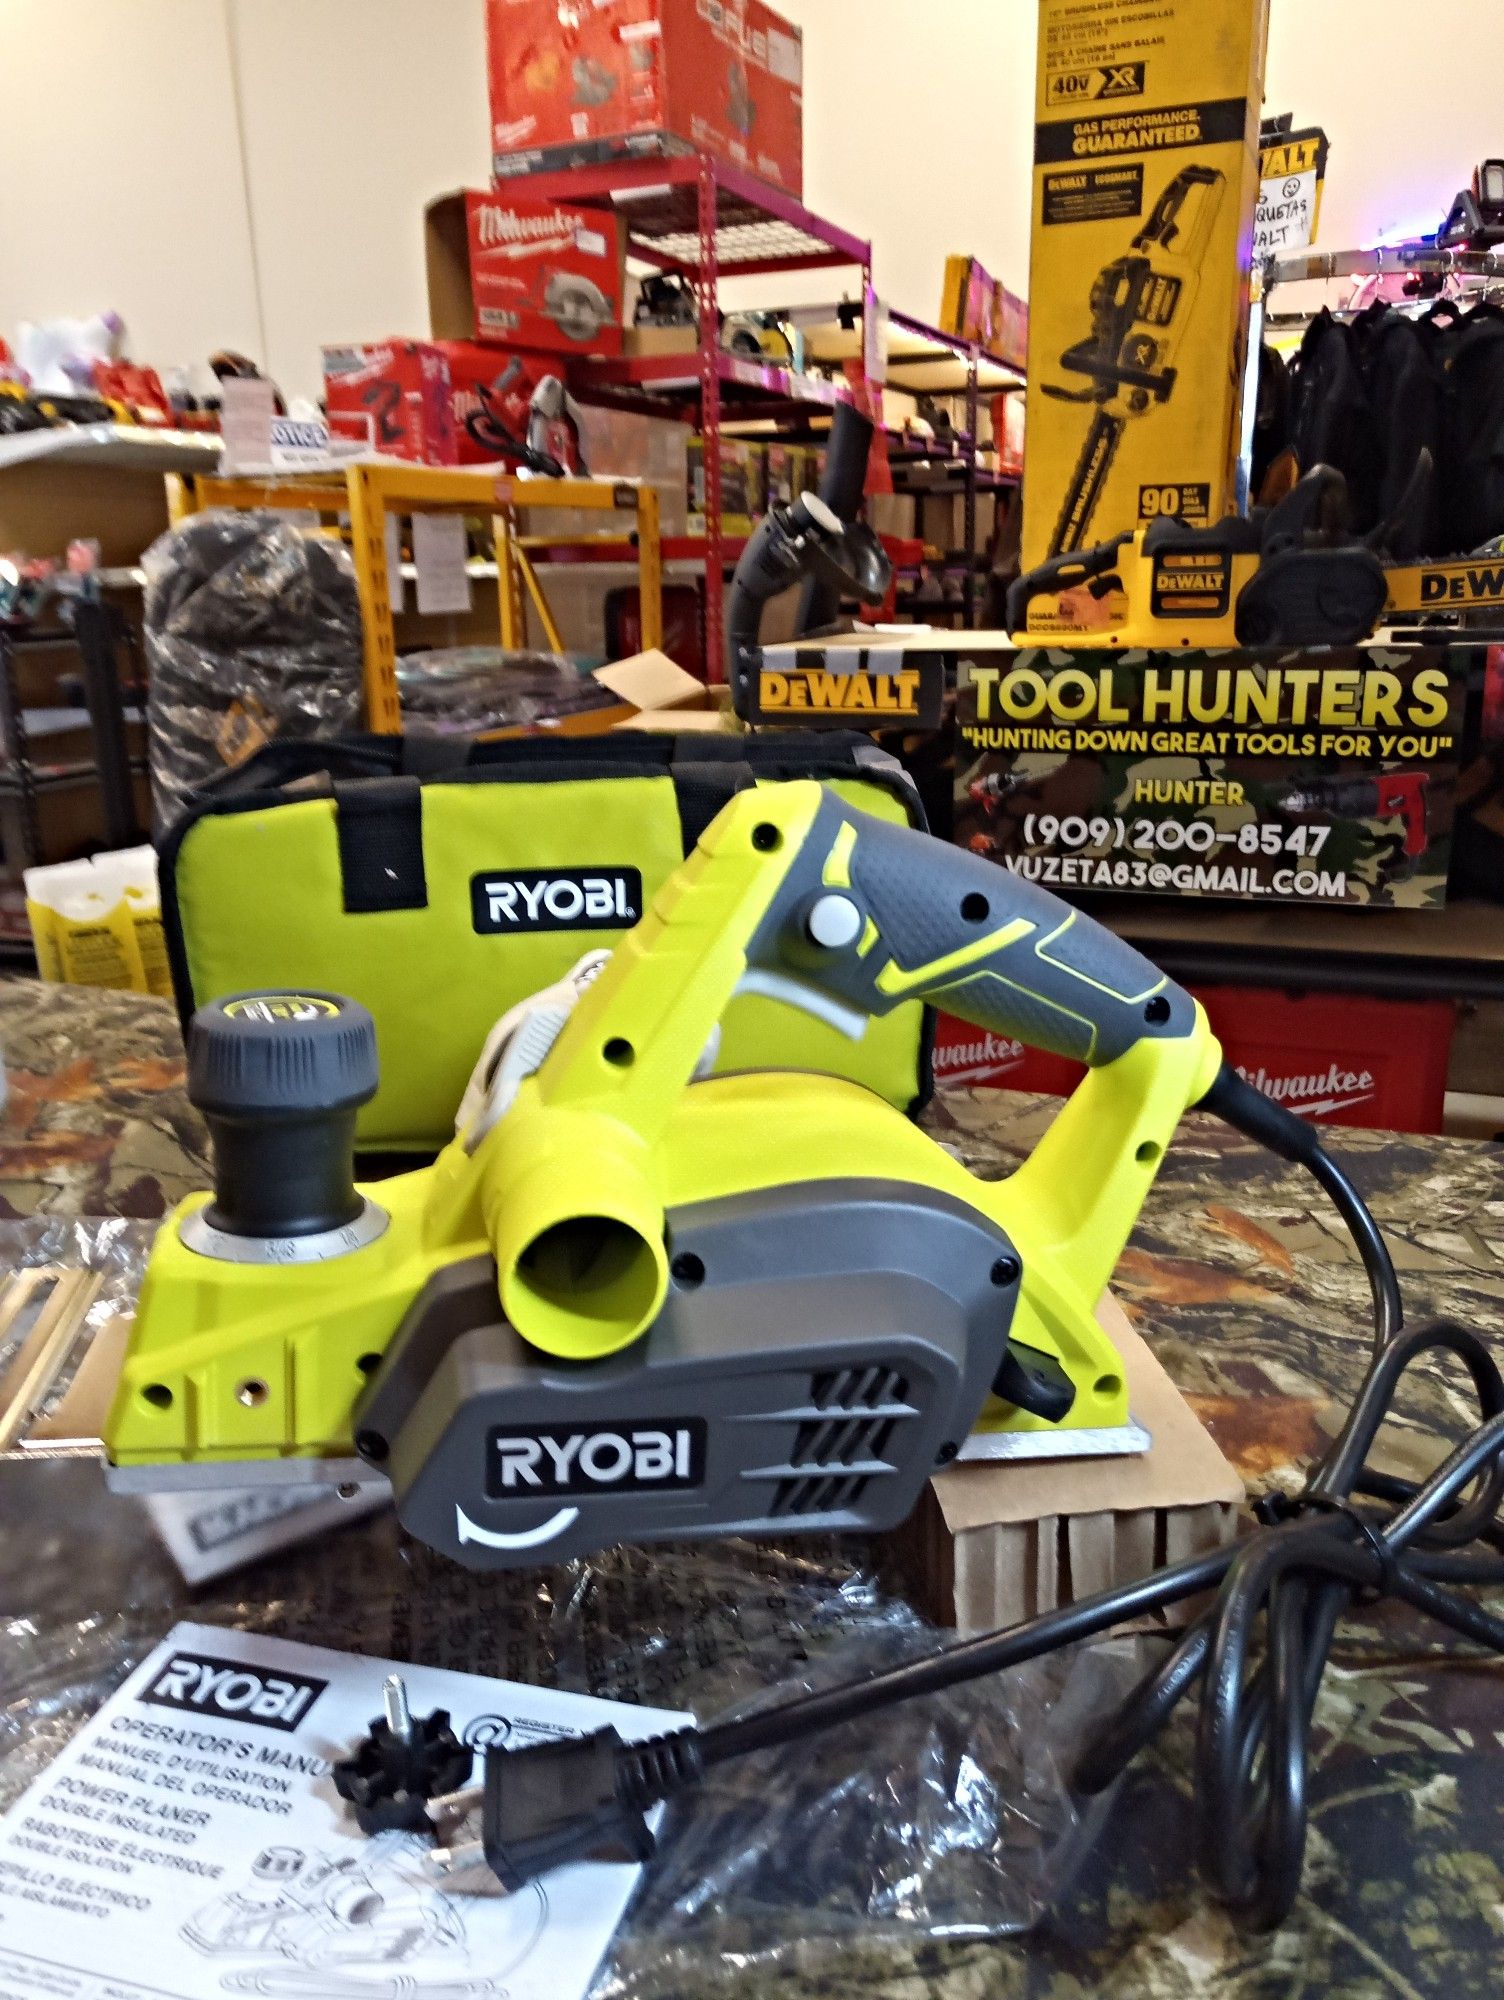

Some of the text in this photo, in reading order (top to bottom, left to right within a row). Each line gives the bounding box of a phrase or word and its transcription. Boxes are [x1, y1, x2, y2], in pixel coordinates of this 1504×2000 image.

[1073, 120, 1099, 137] GAS
[1260, 138, 1320, 177] ALT
[1142, 487, 1179, 516] 90
[1157, 574, 1224, 588] DEWALT
[760, 671, 921, 708] DEWALT
[968, 668, 1450, 728] TOOL HUNTERS
[962, 726, 1453, 759] "HUNTING DOWN GREAT TOOLS FOR YOU"
[1135, 778, 1246, 806] HUNTER
[1004, 854, 1347, 898] VUZETA83@GMAIL.COM
[485, 878, 628, 923] RYOBI
[496, 1429, 691, 1488] RYOBI
[153, 1659, 314, 1723] RYOBI
[93, 1736, 293, 1794] MANUEL D'UTILISATION
[110, 1716, 332, 1778] OPERATOR'S MANU
[55, 1774, 212, 1828] POWER PLANER
[77, 1752, 294, 1816] MANUAL DEL OPERADOR
[21, 1815, 120, 1854] RABOTEUSE
[40, 1793, 197, 1847] DOUBLE INSULATED
